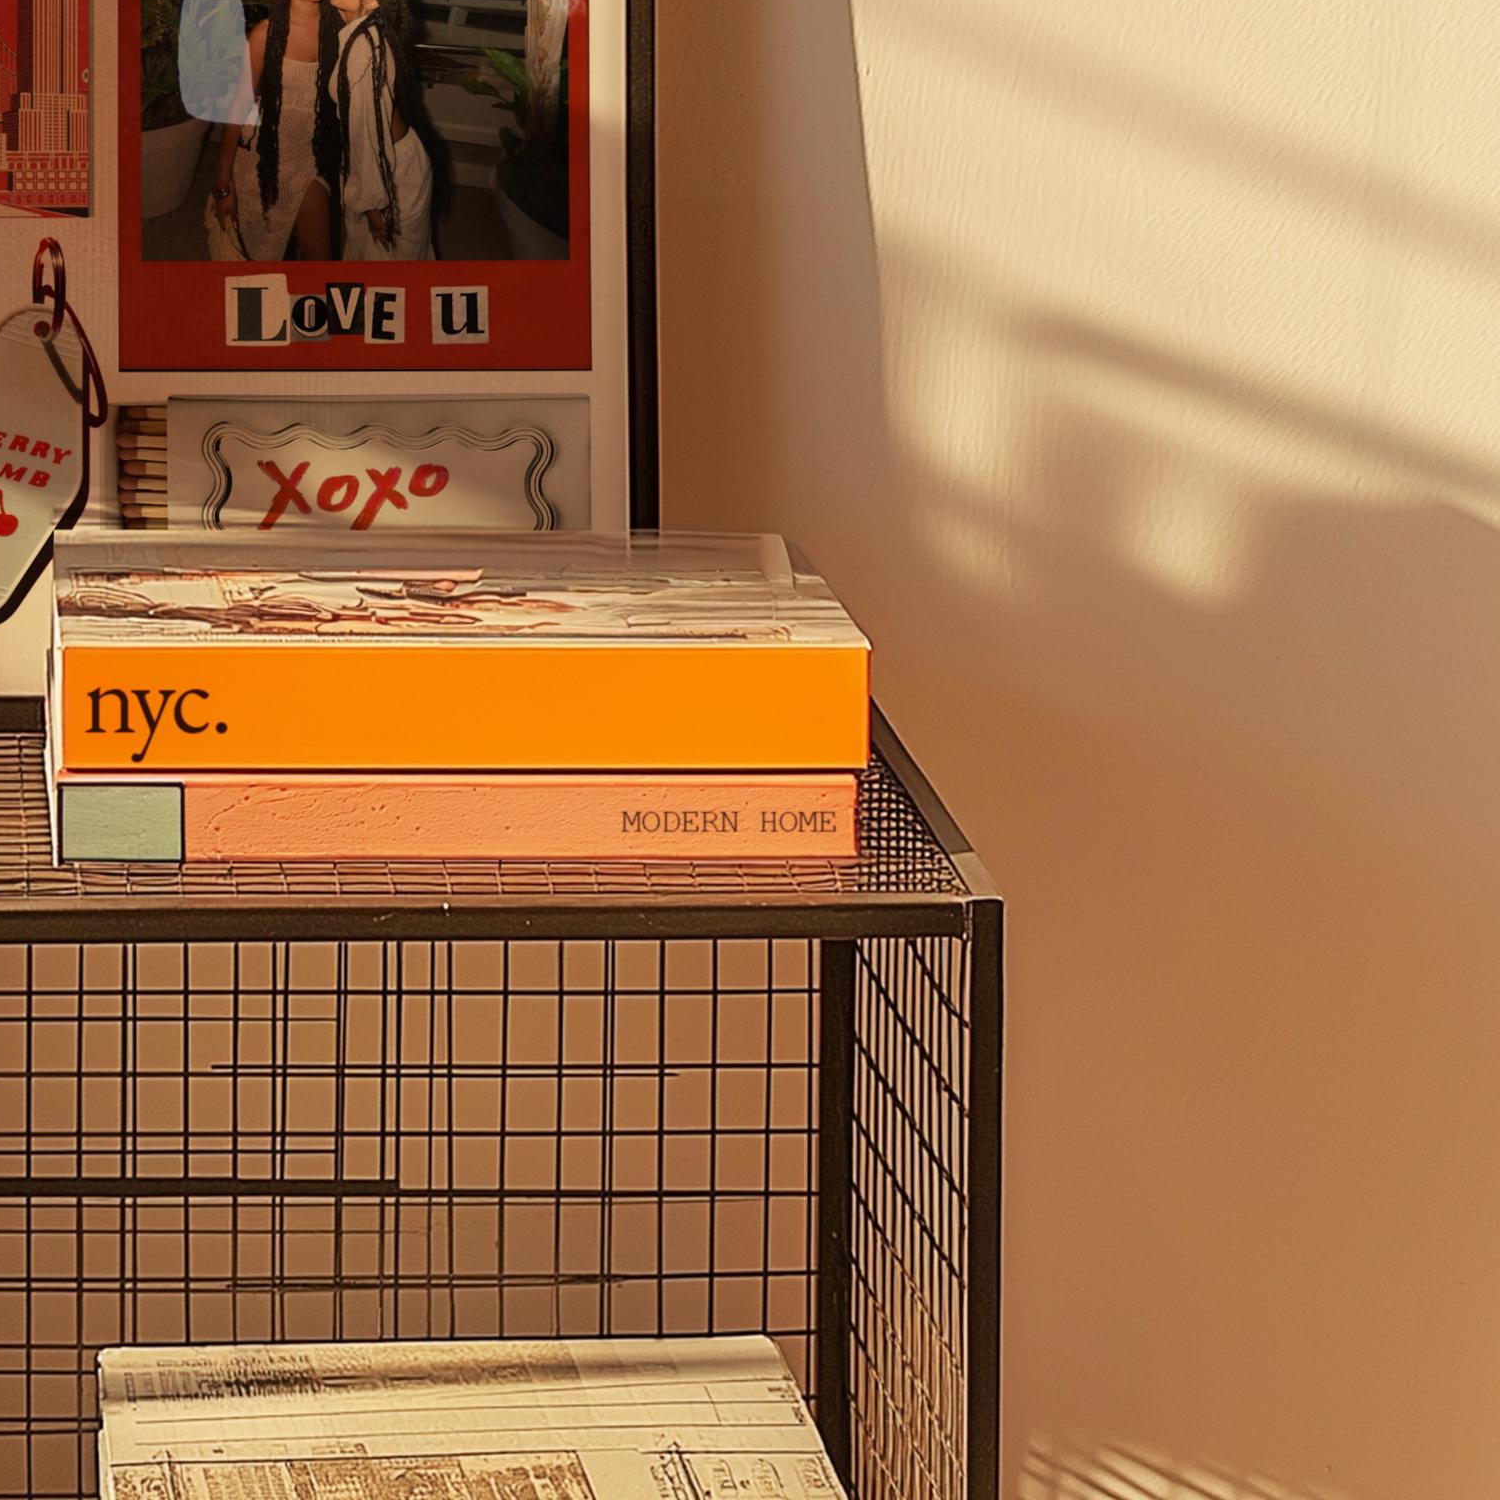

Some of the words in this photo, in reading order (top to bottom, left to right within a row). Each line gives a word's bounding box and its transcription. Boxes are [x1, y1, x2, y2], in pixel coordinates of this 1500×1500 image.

[85, 687, 228, 763] nyc.
[621, 811, 738, 833] MODERN
[760, 811, 837, 833] HOME
